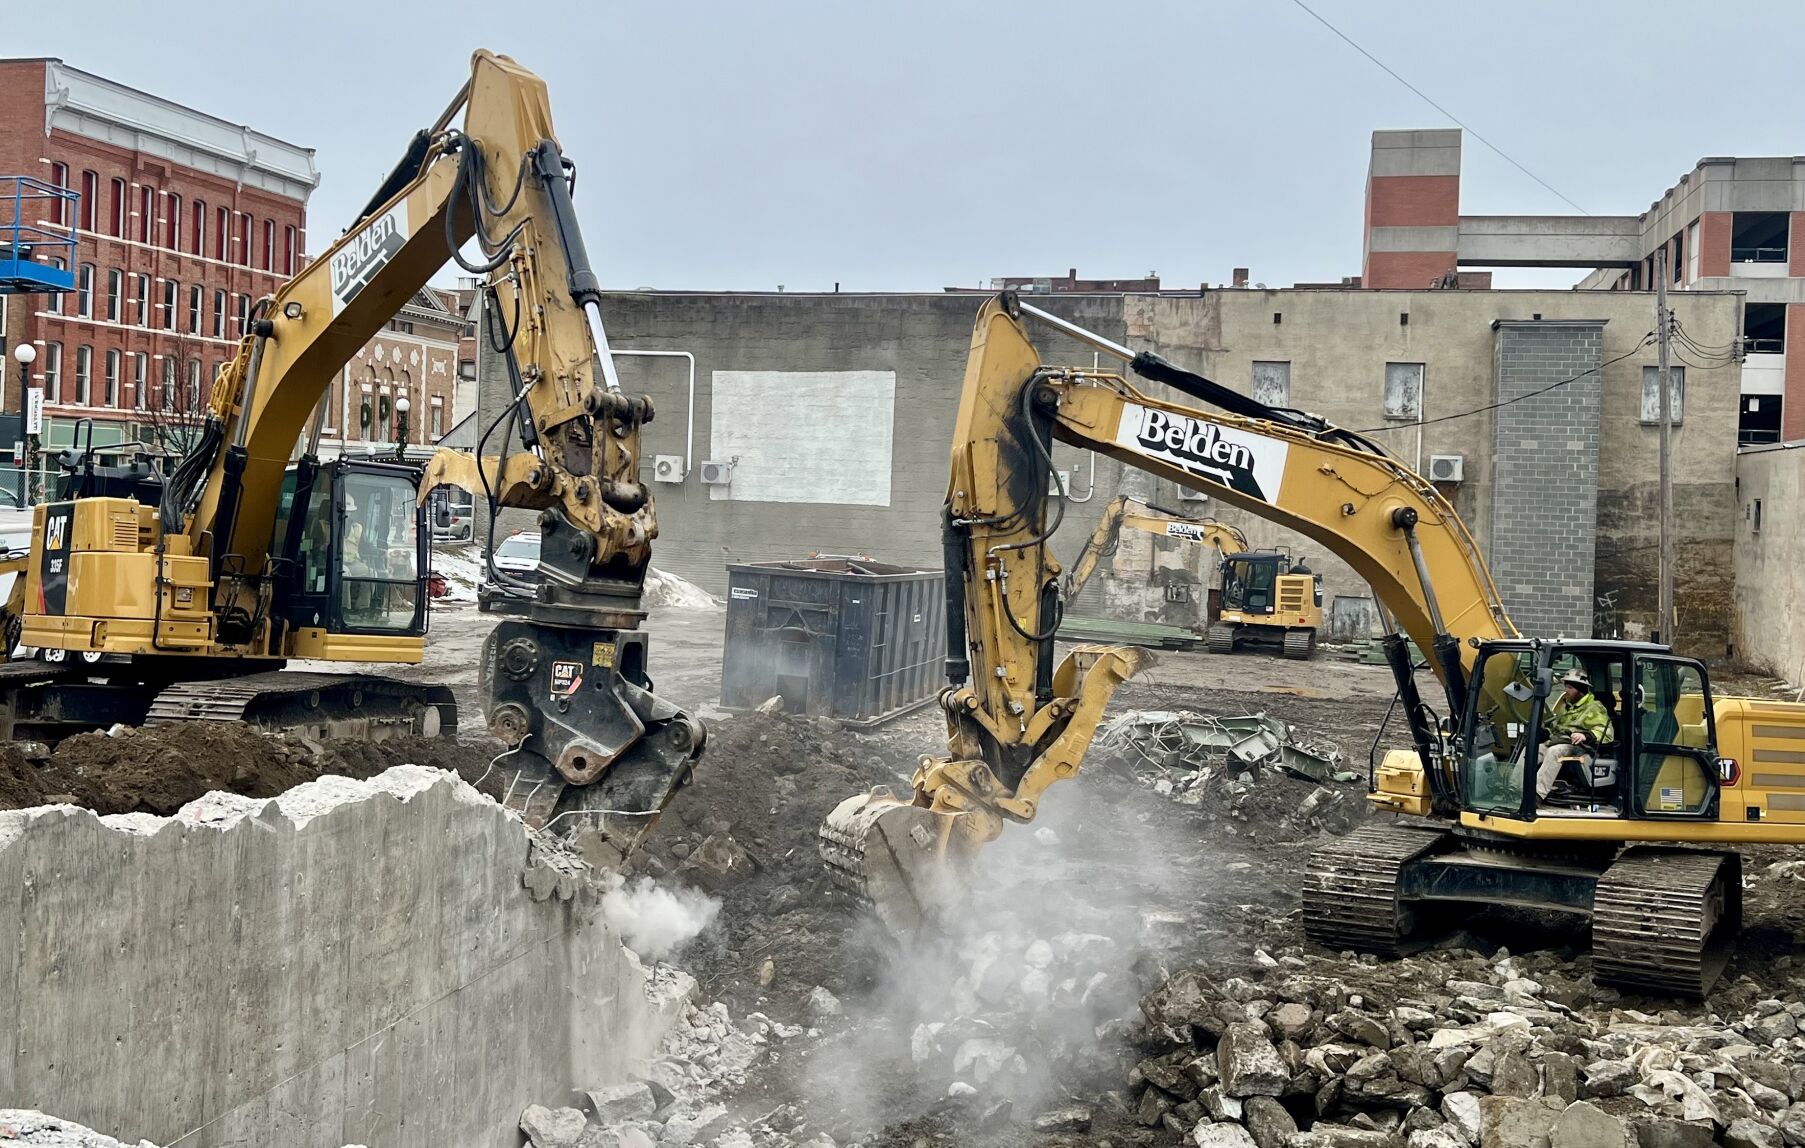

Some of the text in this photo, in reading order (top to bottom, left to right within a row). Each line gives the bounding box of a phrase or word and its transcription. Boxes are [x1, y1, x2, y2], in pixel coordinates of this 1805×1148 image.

[333, 214, 396, 296] Belden
[1137, 406, 1255, 474] Belden
[46, 515, 67, 550] CAT
[555, 664, 575, 678] CAT
